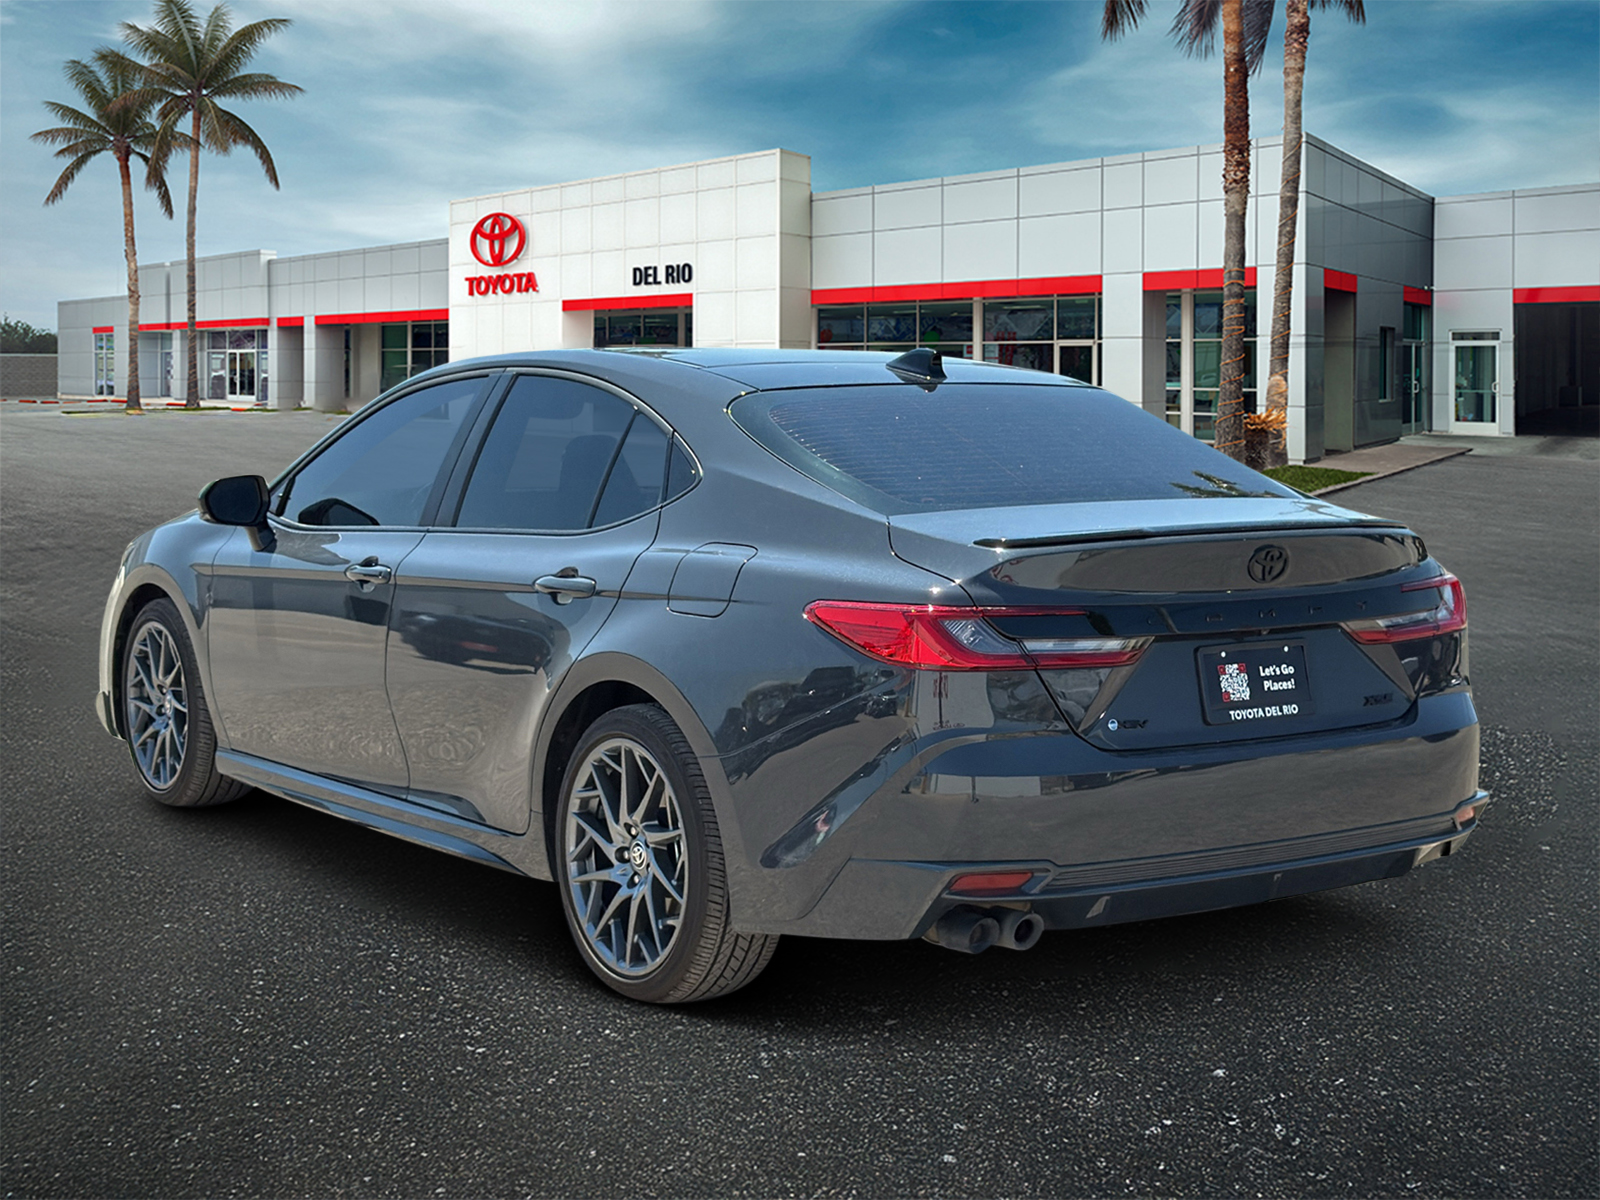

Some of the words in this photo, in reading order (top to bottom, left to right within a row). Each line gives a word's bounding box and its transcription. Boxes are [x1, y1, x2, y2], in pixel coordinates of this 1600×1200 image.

[632, 266, 661, 286] DEL
[665, 263, 693, 284] RIO
[465, 272, 538, 296] TOYOTA
[1259, 665, 1281, 677] Let's
[1281, 664, 1295, 675] Go
[1263, 678, 1295, 691] Places!
[1229, 707, 1265, 720] TOYOTA
[1265, 705, 1282, 717] DEL
[1283, 704, 1299, 715] RIO
